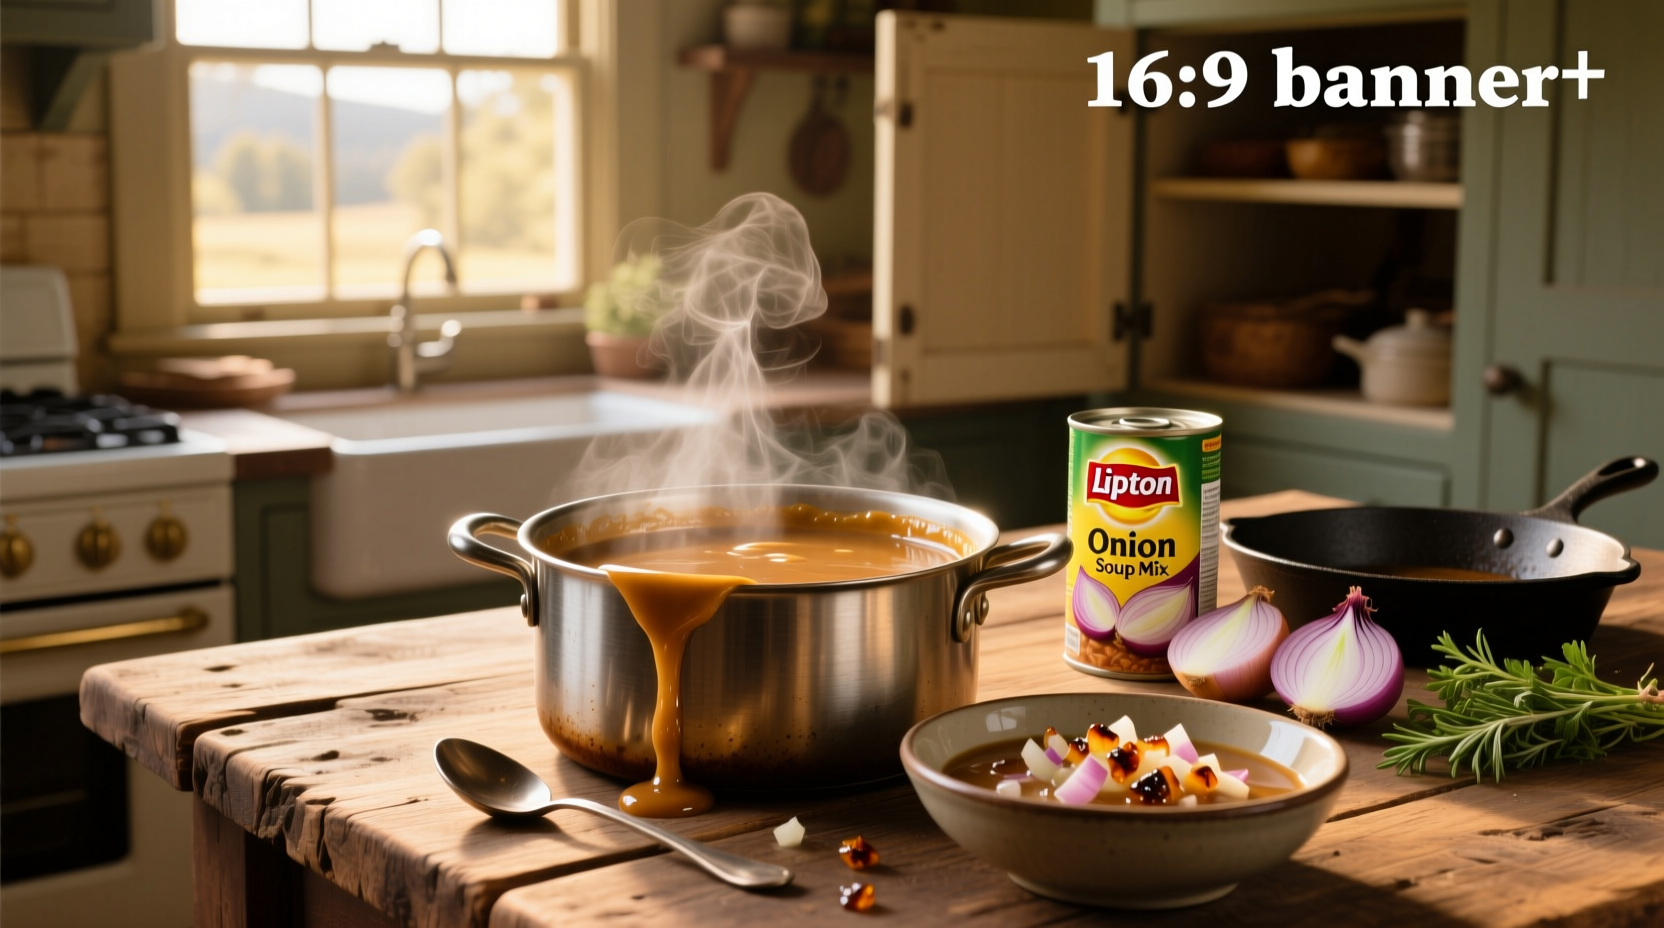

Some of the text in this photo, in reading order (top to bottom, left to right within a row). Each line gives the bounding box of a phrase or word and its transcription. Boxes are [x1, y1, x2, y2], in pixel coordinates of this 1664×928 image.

[1091, 467, 1173, 501] Lipton
[1088, 527, 1176, 558] Onion
[1095, 557, 1170, 580] Soup Mix
